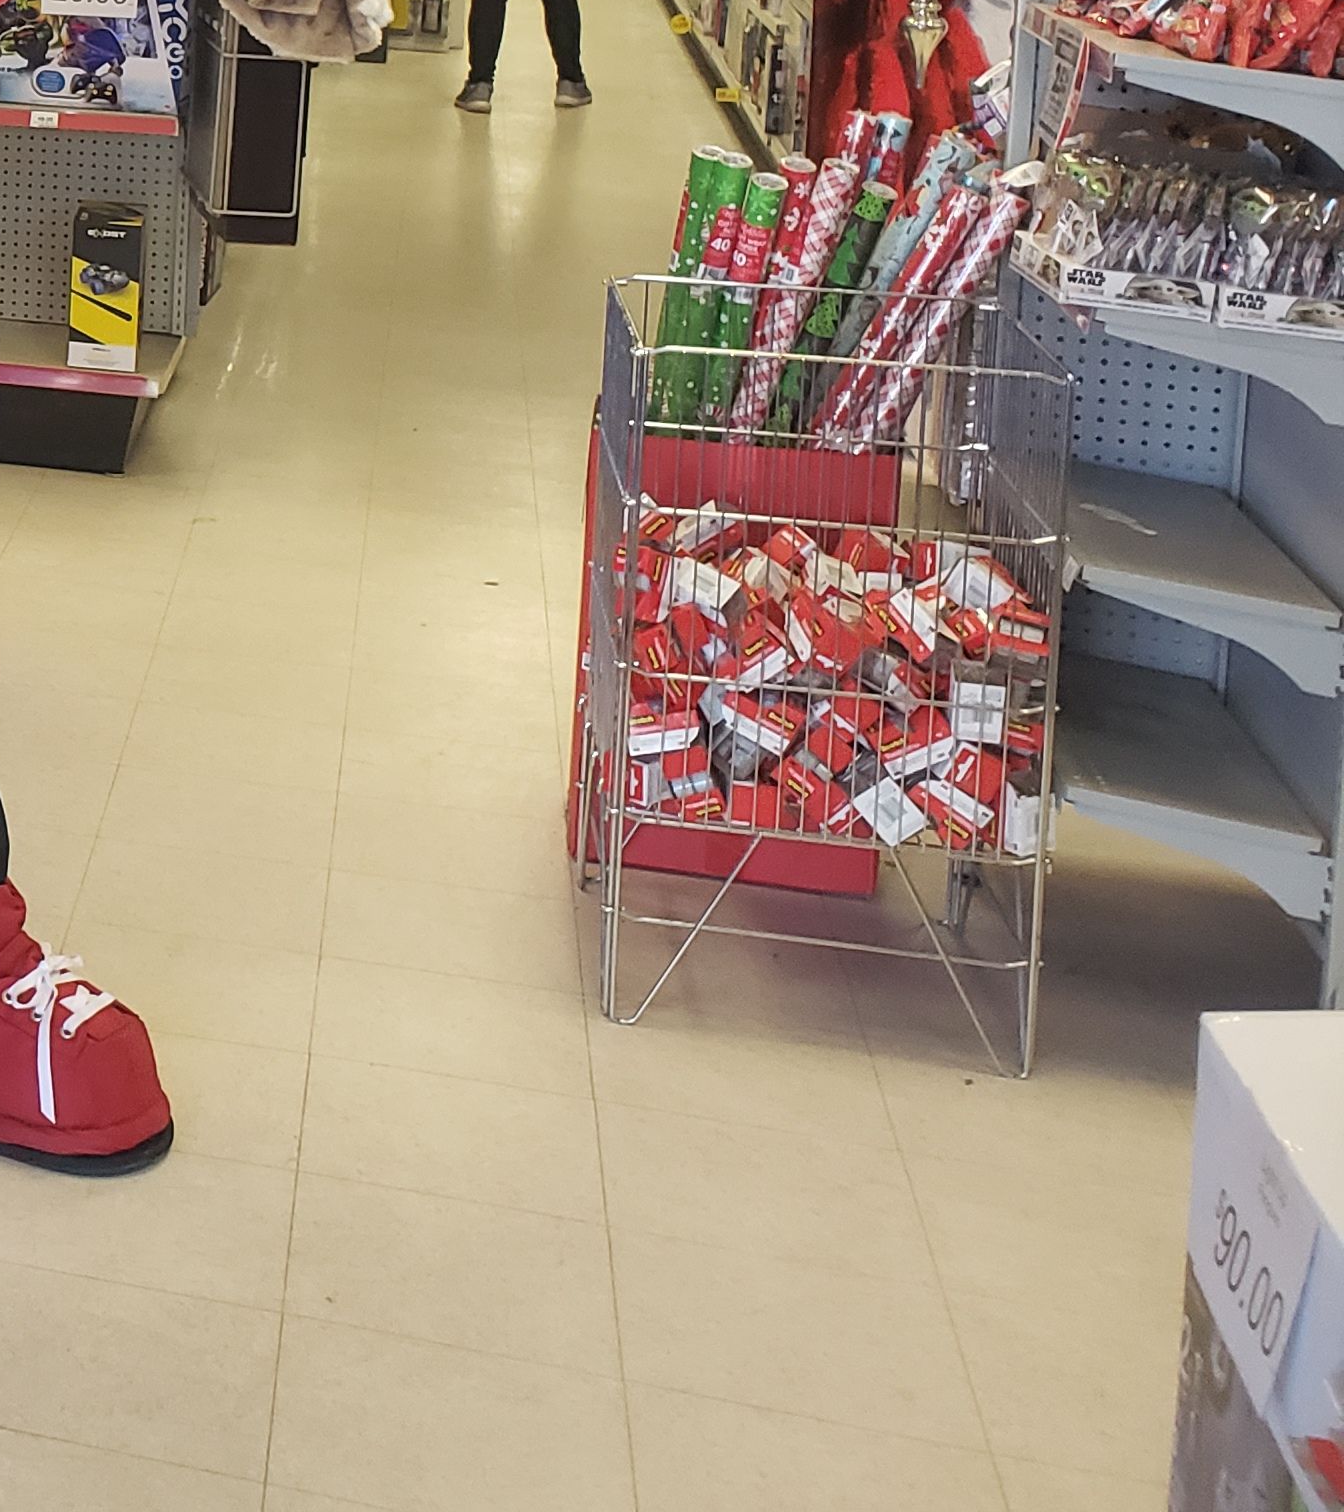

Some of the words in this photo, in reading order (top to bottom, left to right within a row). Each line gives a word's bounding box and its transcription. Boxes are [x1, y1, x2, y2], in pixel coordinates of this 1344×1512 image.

[1069, 268, 1105, 280] STAR
[1067, 275, 1107, 288] WARS
[1229, 292, 1264, 302] STAR
[1227, 299, 1268, 310] WARS
